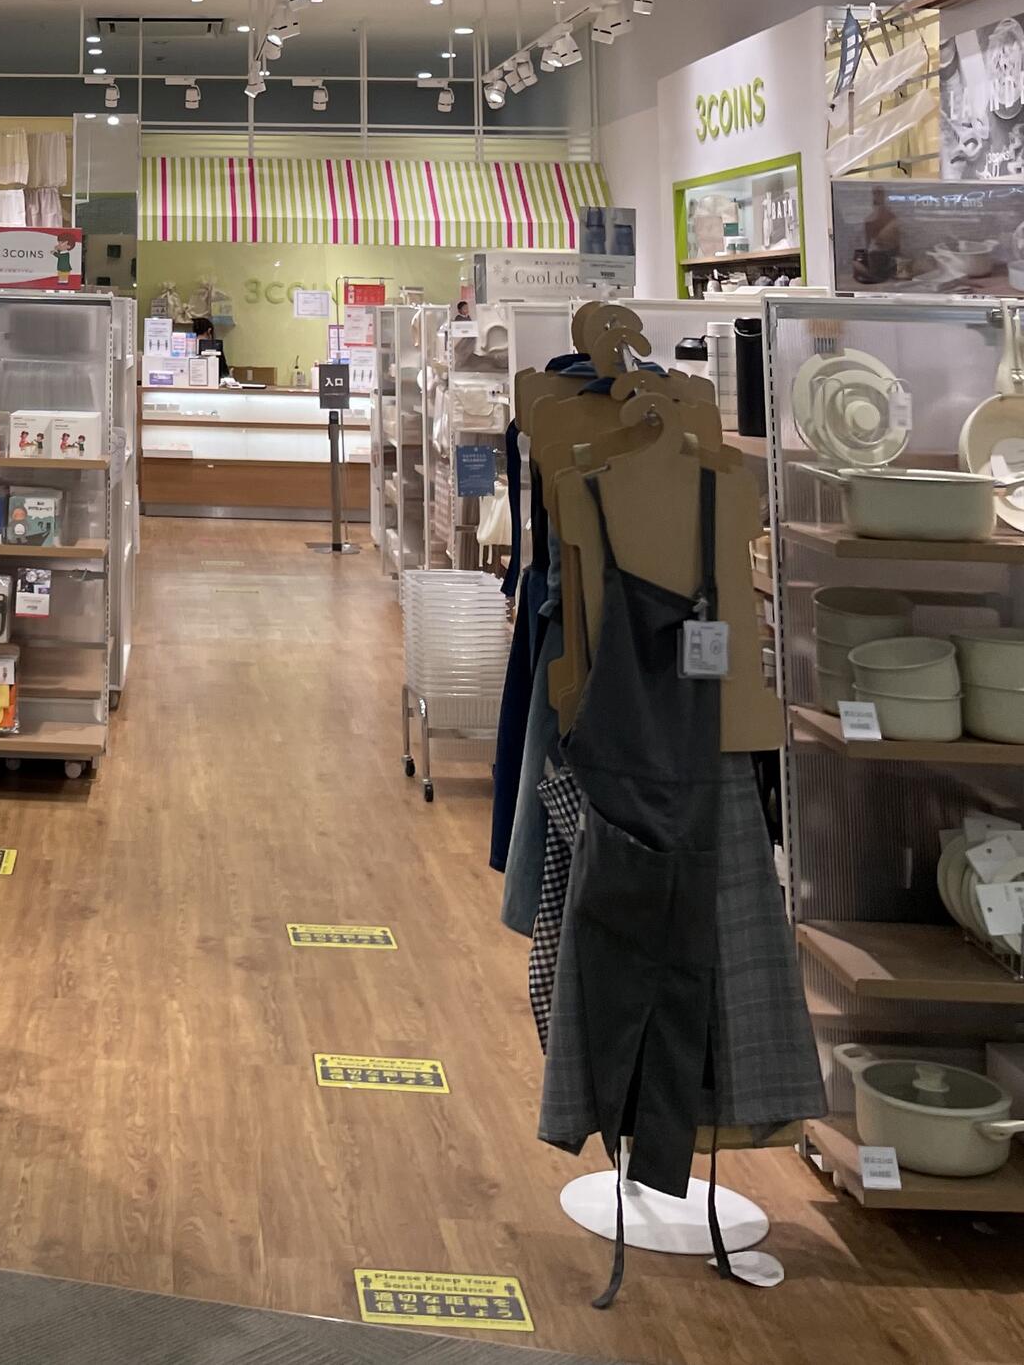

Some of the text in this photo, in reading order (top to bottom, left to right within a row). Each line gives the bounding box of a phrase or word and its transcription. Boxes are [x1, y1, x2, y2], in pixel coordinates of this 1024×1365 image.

[695, 76, 766, 142] 3COINS
[2, 248, 44, 259] 3COINS
[515, 270, 551, 284] Cool
[325, 377, 344, 387] 入口
[374, 1273, 498, 1286] Please Keep Your
[383, 1281, 494, 1294] Social Distance
[374, 1291, 510, 1307] 適切な距離を
[376, 1302, 513, 1318] 保ちましょう
